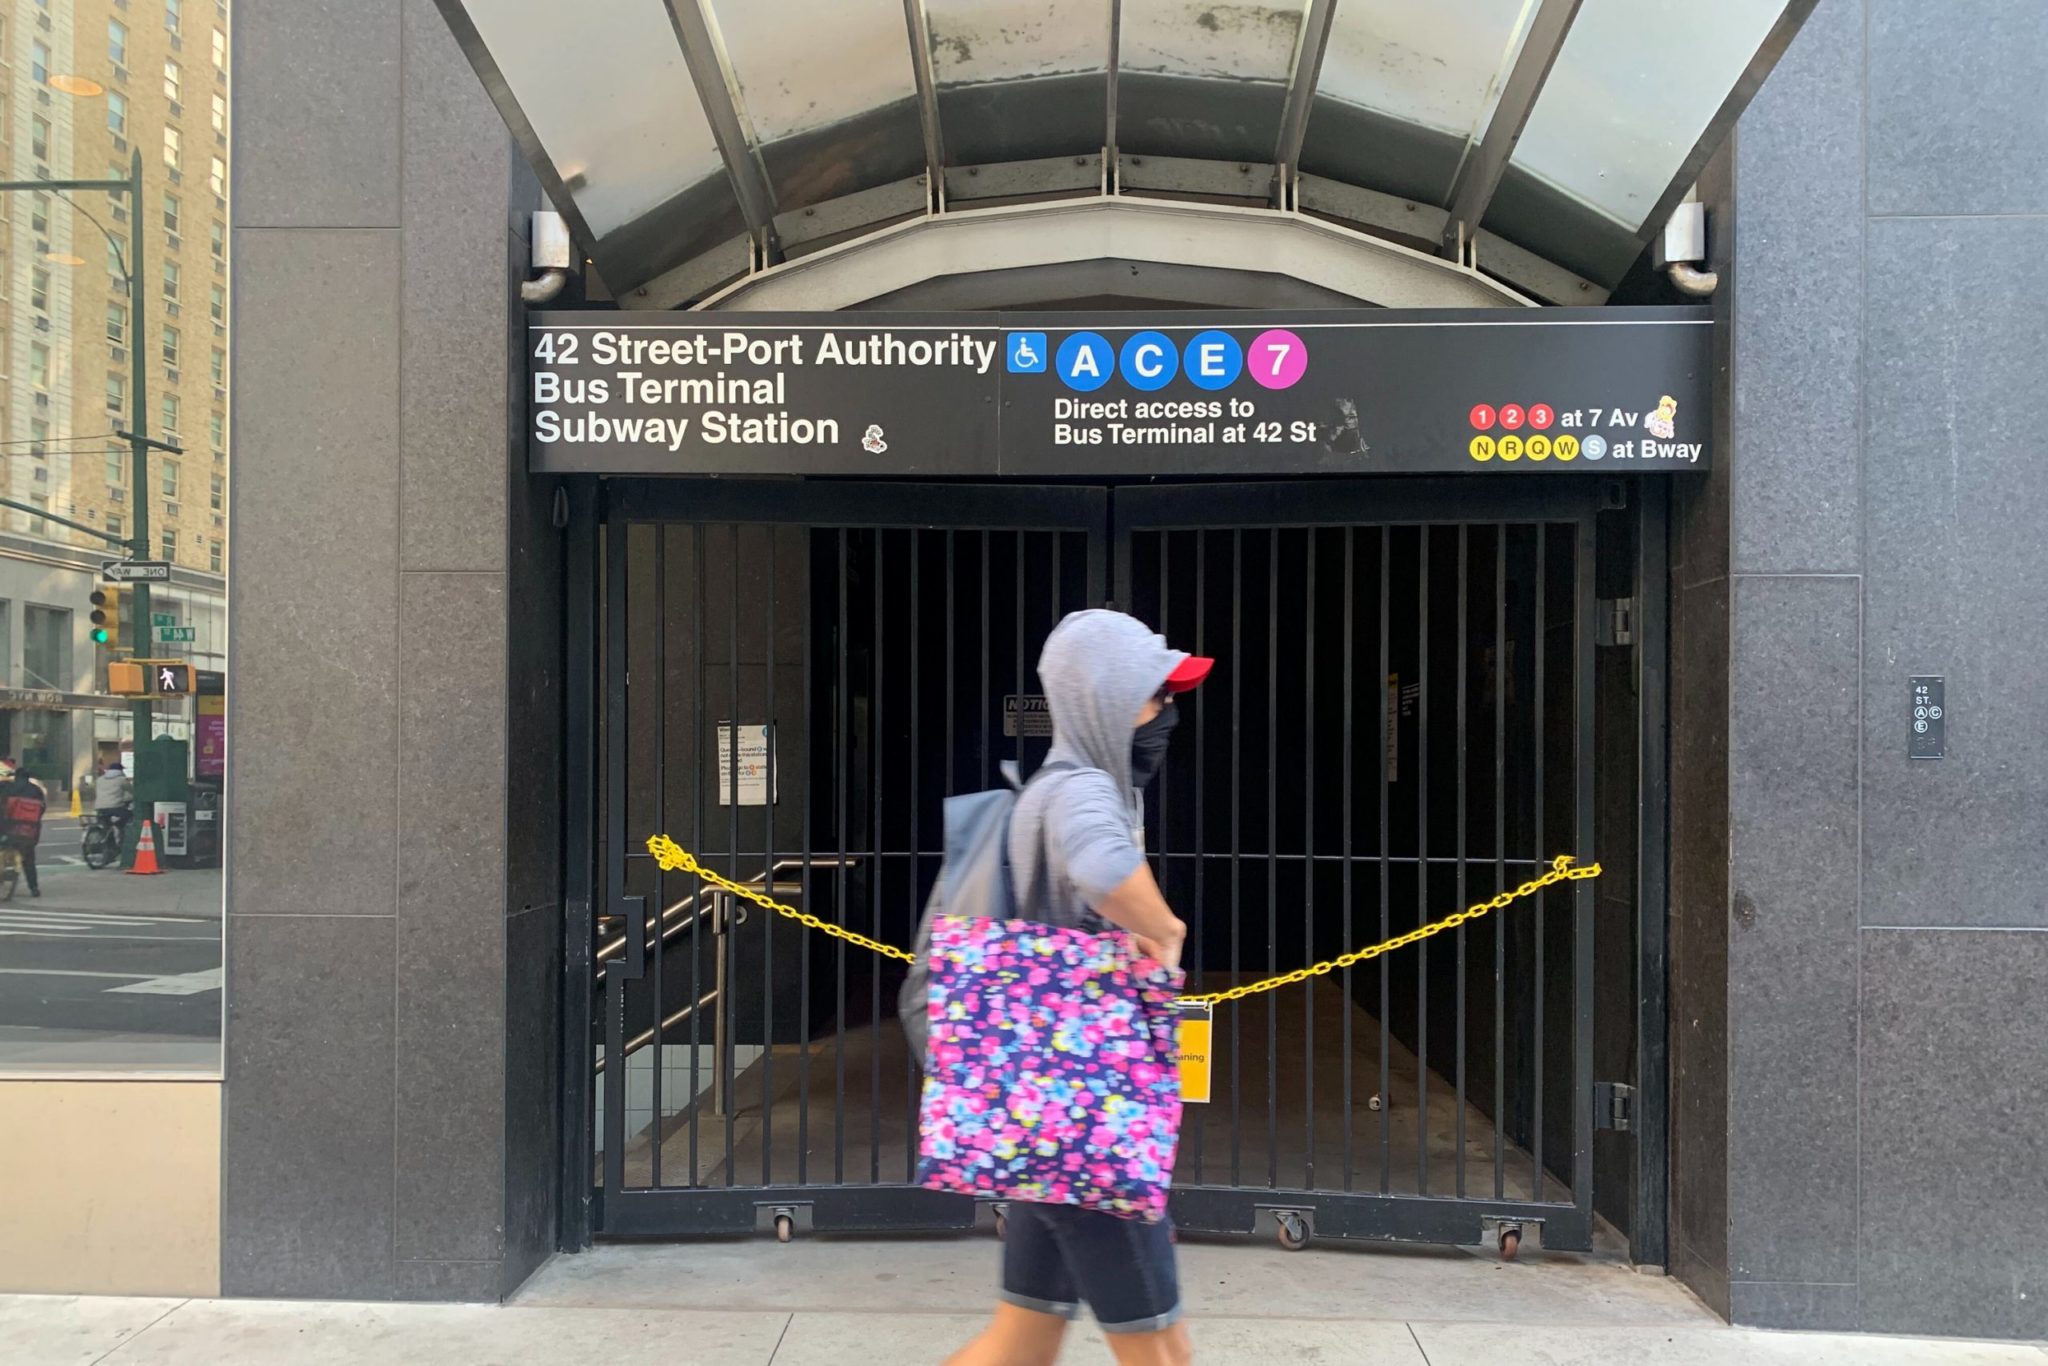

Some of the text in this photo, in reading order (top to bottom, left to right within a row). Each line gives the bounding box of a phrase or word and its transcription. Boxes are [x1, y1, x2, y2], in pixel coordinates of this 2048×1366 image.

[534, 331, 997, 374] 42 Street-Port Authority
[534, 371, 785, 405] Bus Terminal
[1054, 397, 1255, 419] Direct access to
[1561, 409, 1583, 428] at
[1588, 408, 1603, 427] 7
[1608, 408, 1639, 427] Av
[535, 410, 839, 452] Subway Station
[1054, 420, 1317, 445] Bus Terminal at 42 St
[1612, 440, 1635, 459] at
[1640, 439, 1702, 463] Bway
[1915, 686, 1928, 694] 42
[1008, 699, 1049, 710] NOTIC
[1178, 1052, 1205, 1063] aning
